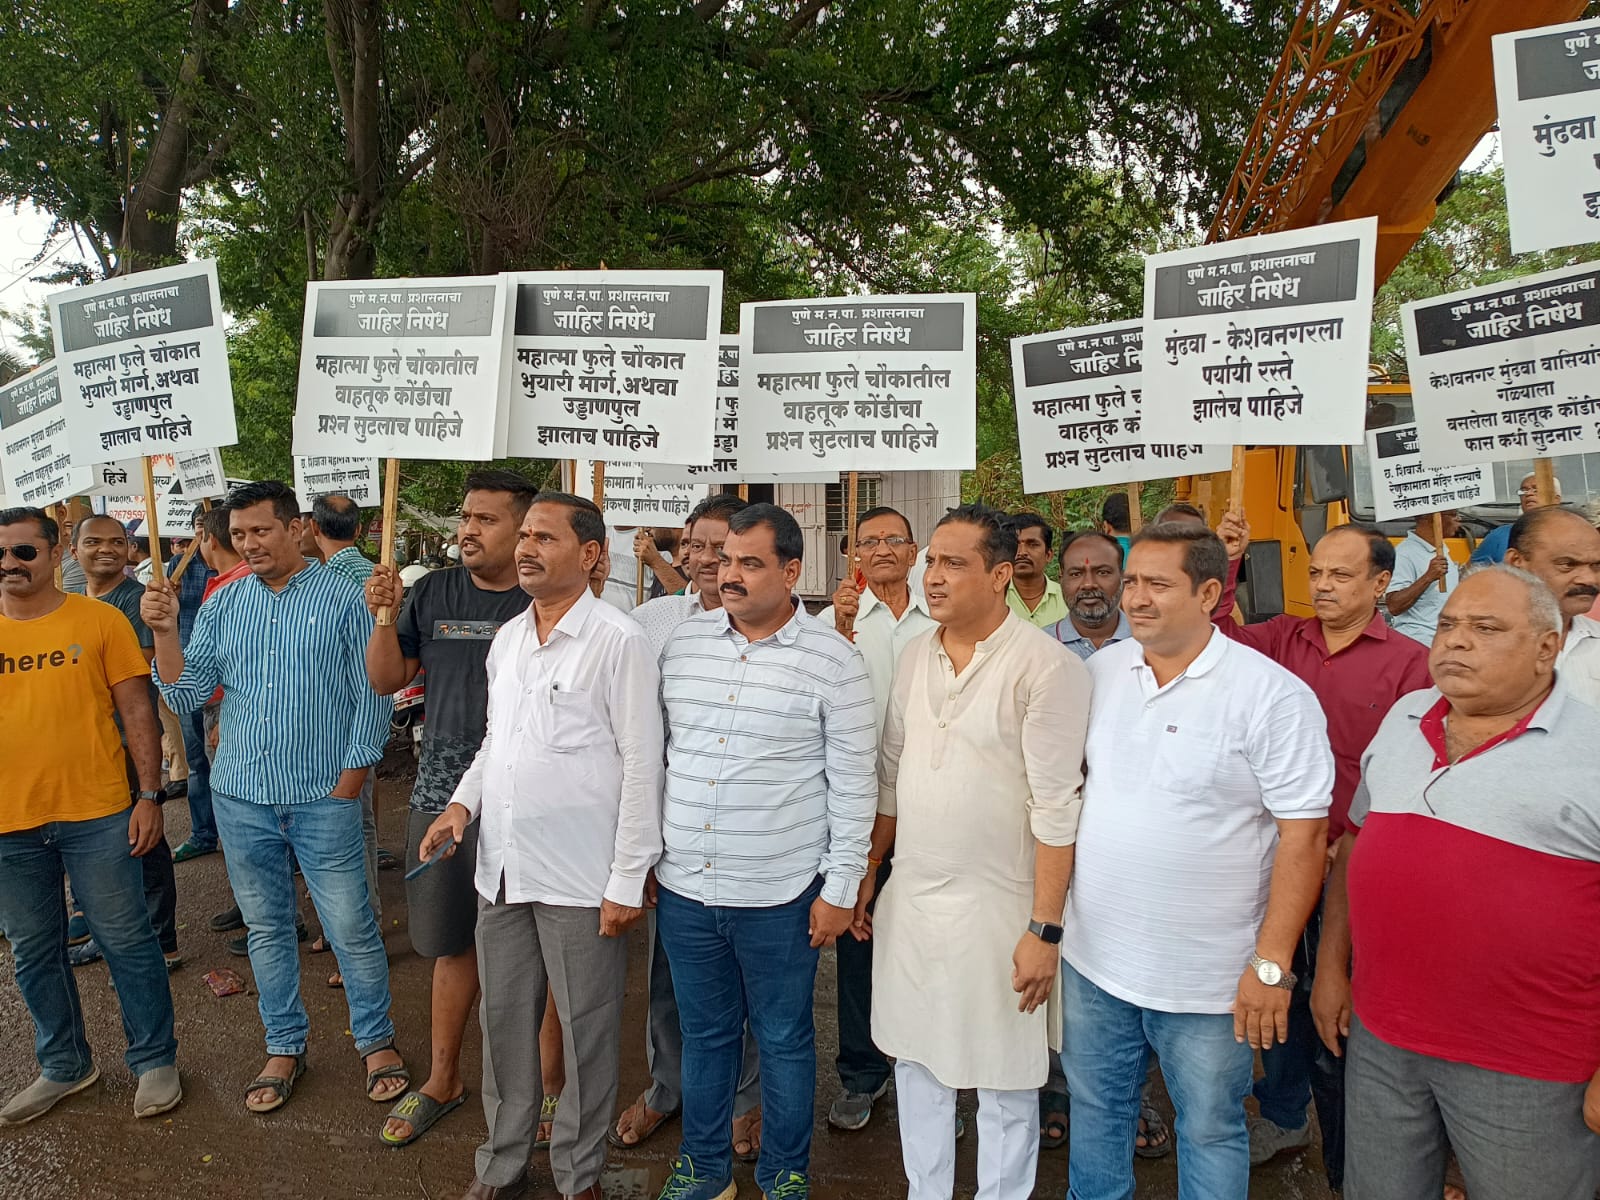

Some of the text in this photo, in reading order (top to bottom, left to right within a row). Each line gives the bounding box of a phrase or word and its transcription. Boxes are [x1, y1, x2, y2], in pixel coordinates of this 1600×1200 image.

[1564, 32, 1590, 57] पुणे
[1532, 114, 1596, 157] मुंढवा
[1188, 264, 1204, 285] पुणे
[1250, 251, 1316, 273] प्रशासनाचा
[83, 299, 97, 319] पुणे
[130, 285, 180, 304] प्रशासनाचा
[350, 290, 365, 309] पुणे
[407, 292, 462, 304] प्रशासनाचा
[543, 287, 560, 306] पुणे
[608, 290, 670, 303] प्रशासनाचा
[1197, 272, 1300, 309] जाहिर निषेध
[1451, 300, 1471, 321] पुणे
[1523, 277, 1596, 302] प्रशासनाचा
[94, 305, 172, 339] जाहिर निषेध
[358, 307, 449, 334] जाहिर निषेध
[553, 305, 655, 334] जाहिर निषेध
[792, 307, 810, 325] पुणे
[862, 308, 925, 319] प्रशासनाचा
[1466, 300, 1583, 340] जाहिर निषेध
[804, 321, 911, 348] जाहिर निषेध
[1057, 339, 1075, 357] पुणे
[1165, 330, 1206, 366] मुंढवा
[1227, 318, 1344, 350] केशवनगरला
[73, 340, 201, 379] महात्मा फुले चौकात
[316, 349, 479, 382] महात्मा फुले चौकातील
[517, 344, 686, 374] महात्मा फुले चौकात
[1070, 351, 1120, 374] जाहिर
[1203, 351, 1294, 385] पर्यायी रस्ते
[1430, 367, 1496, 390] केशवनगर
[1499, 359, 1536, 385] मुंढवा
[79, 376, 118, 408] भुयारी
[521, 369, 574, 398] भुयारी
[758, 372, 821, 395] महात्मा
[826, 364, 859, 397] फुले
[865, 363, 951, 389] चौकातील
[1497, 380, 1555, 402] गळ्याला
[112, 393, 173, 420] उड्डाणपुल
[336, 380, 452, 413] वाहतूक कोंडीचा
[563, 397, 640, 424] उड्डाणपुल
[783, 393, 922, 427] वाहतूक कोंडीचा
[1033, 395, 1090, 419] महात्मा
[1095, 385, 1126, 417] फुले
[1193, 386, 1303, 423] झालेच पाहिजे
[100, 415, 192, 450] झालाच पाहिजे
[318, 411, 463, 443] प्रश्न सुटलाच पाहिजे
[1058, 419, 1119, 444] वाहतूक
[1447, 409, 1498, 432] वसलेला
[1502, 405, 1554, 428] वाहतूक
[537, 424, 659, 451] झालाच पाहिजे
[766, 431, 804, 451] प्रश्न
[809, 430, 876, 458] सुटलाच
[881, 423, 938, 453] पाहिजे
[1465, 435, 1494, 452] फास
[1499, 430, 1528, 449] कधी
[1532, 425, 1584, 456] सुटनार
[1046, 451, 1079, 469] प्रश्न
[1084, 444, 1146, 472] सुटलाच
[633, 494, 660, 513] झालेच
[662, 496, 690, 515] पाहिजे
[1457, 483, 1481, 501] पाहिजे
